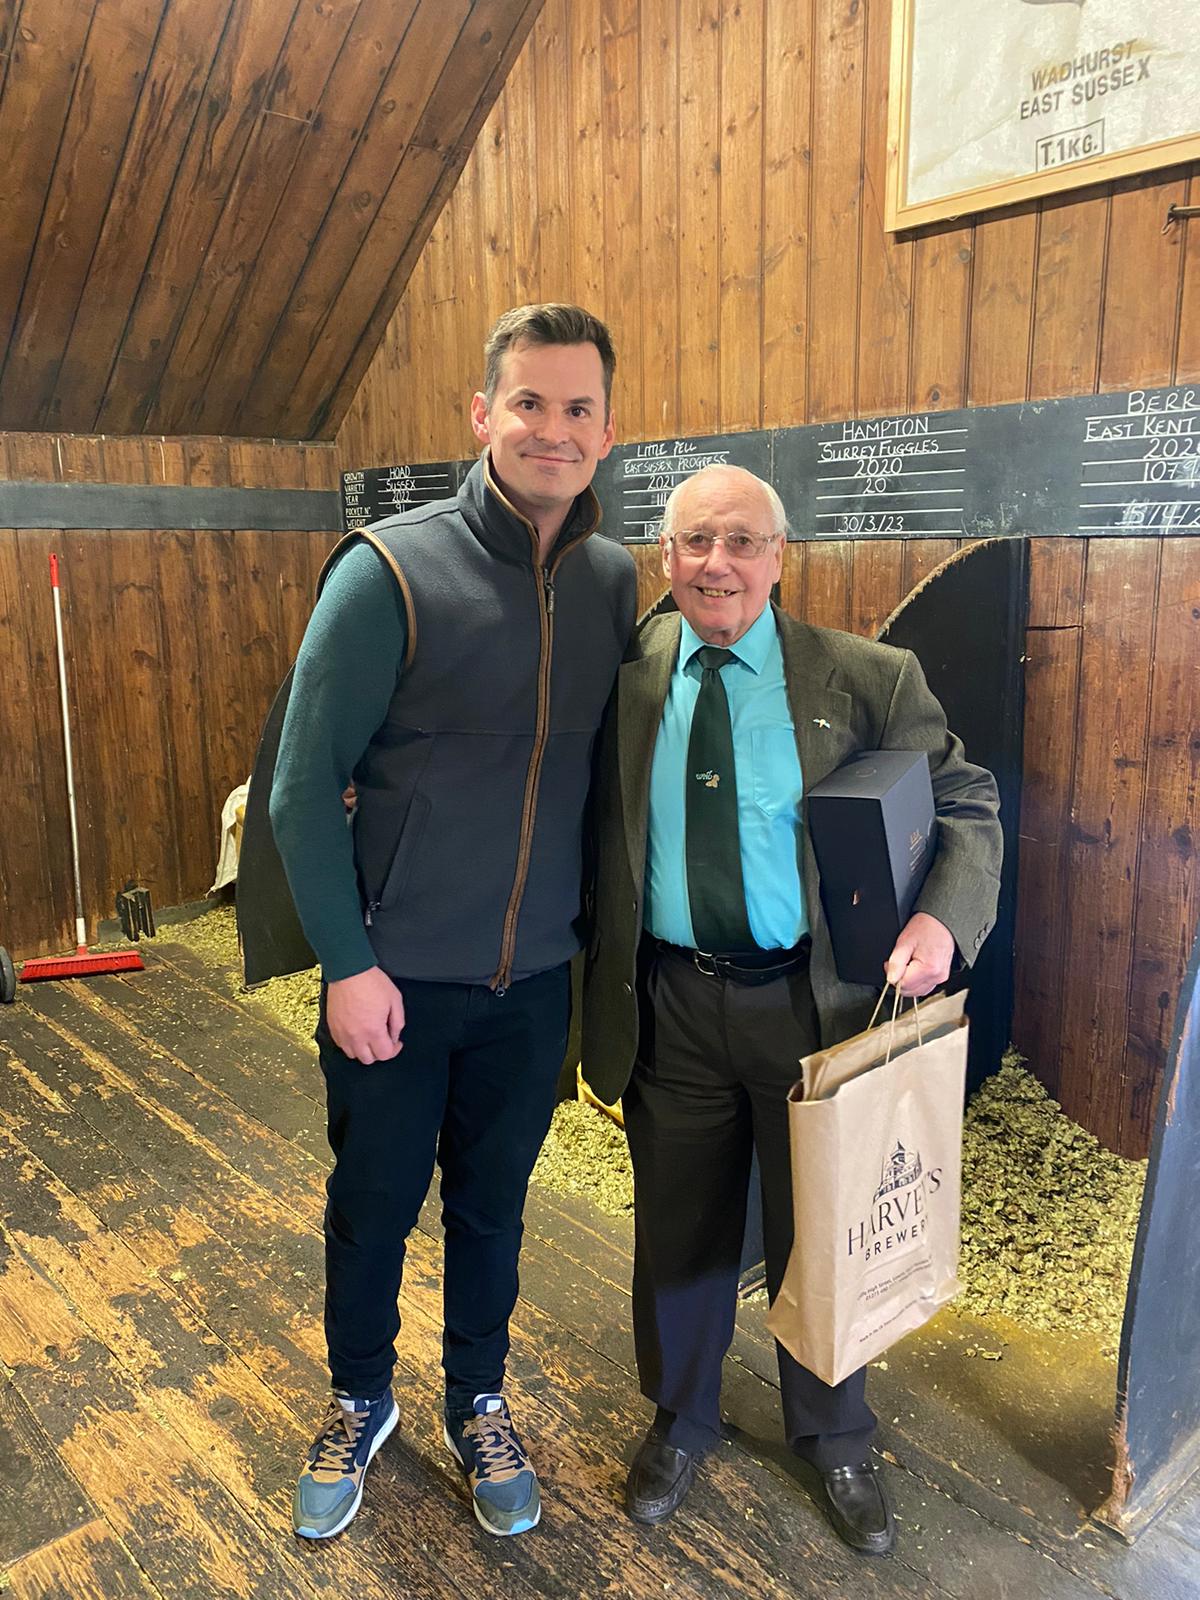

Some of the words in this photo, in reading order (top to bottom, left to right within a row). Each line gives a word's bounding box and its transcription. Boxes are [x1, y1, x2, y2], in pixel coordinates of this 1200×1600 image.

[1032, 38, 1138, 91] WADHURST
[1021, 91, 1064, 120] EAST
[1072, 55, 1151, 105] SUSSEX
[1128, 390, 1200, 414] BERR
[843, 416, 929, 441] HAMPTON
[1086, 420, 1134, 440] EAST
[1143, 415, 1197, 437] KENT
[820, 441, 877, 461] SURREY
[879, 439, 939, 458] FUGGLES
[389, 465, 411, 479] HOAD
[854, 457, 903, 477] 2020
[344, 471, 365, 482] GROWTH
[386, 479, 416, 491] SUSSEX
[647, 474, 674, 490] 2021
[344, 483, 365, 493] VARIETY
[863, 477, 887, 494] 20
[345, 495, 359, 504] YEAR
[392, 490, 411, 503] 2022
[345, 506, 363, 516] POCKET
[346, 518, 366, 528] WEIGHT
[837, 514, 904, 533] 30/3/23
[848, 1168, 942, 1256] HARVE'S
